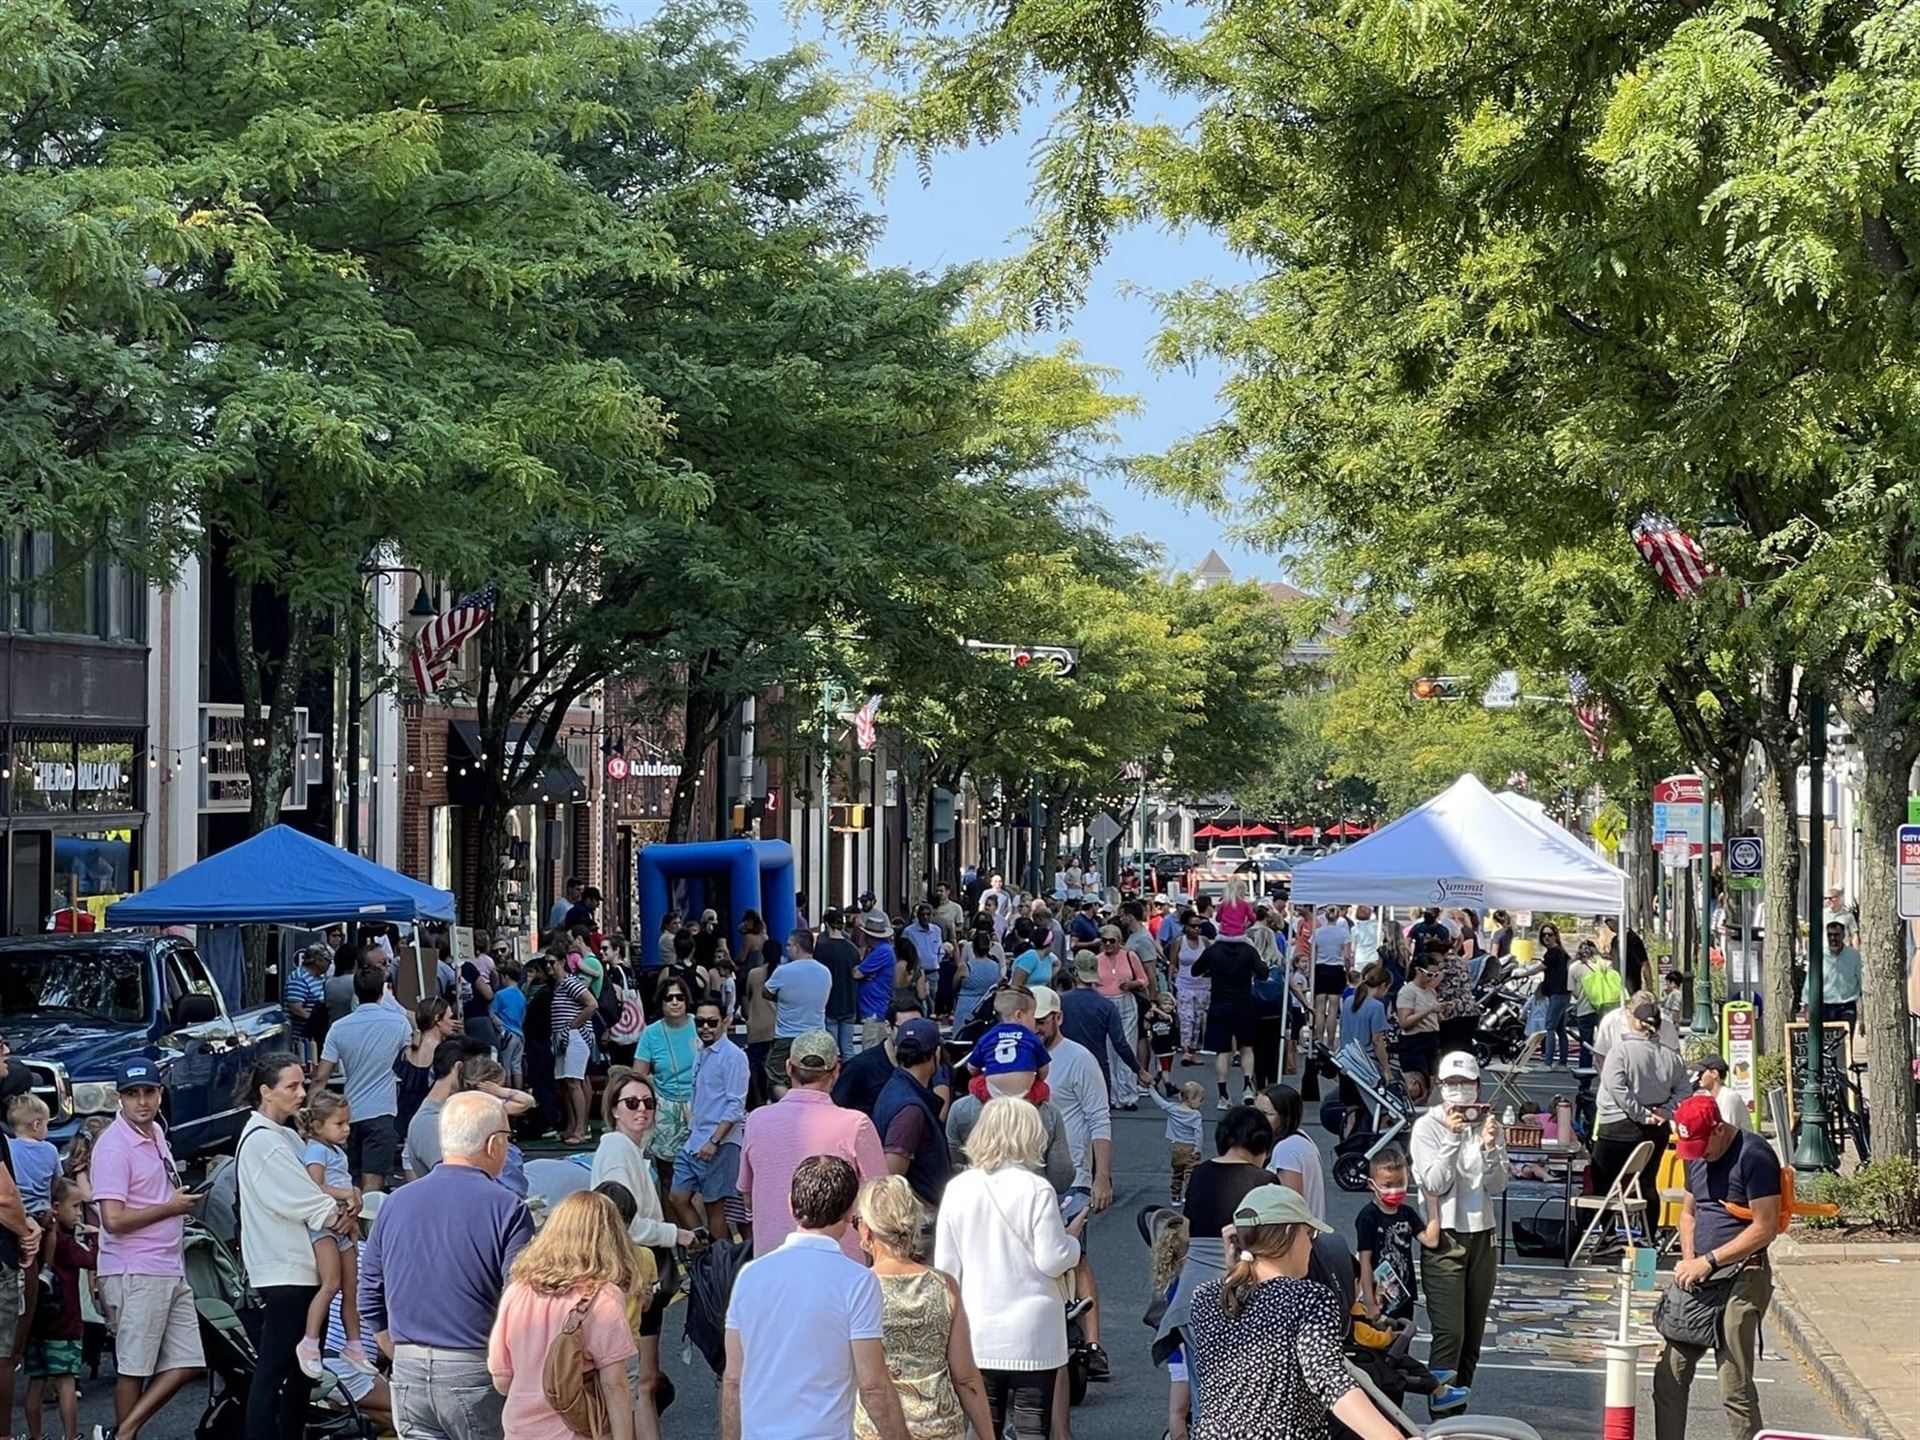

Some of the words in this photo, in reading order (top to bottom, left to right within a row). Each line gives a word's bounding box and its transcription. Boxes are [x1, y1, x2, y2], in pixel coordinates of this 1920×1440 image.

[630, 759, 682, 777] lululem
[1905, 843, 1920, 856] 90
[1429, 878, 1484, 904] Summit
